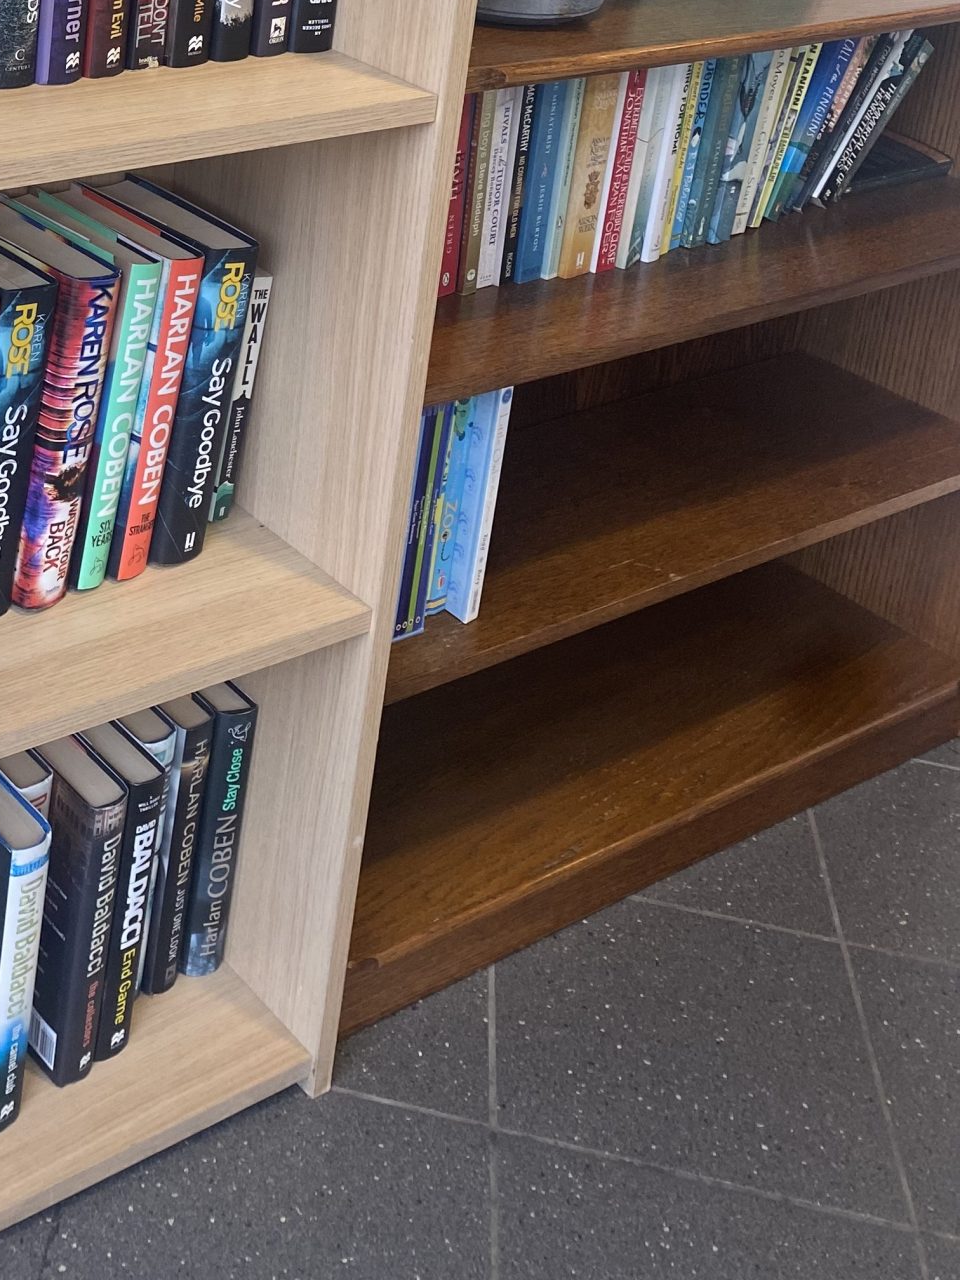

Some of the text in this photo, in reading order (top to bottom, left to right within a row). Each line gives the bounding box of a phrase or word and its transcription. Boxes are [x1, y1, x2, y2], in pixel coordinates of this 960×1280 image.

[110, 12, 124, 40] Evil
[792, 57, 814, 107] RANKIN
[501, 106, 511, 145] RIVALS
[519, 105, 533, 152] McCARTHY
[545, 95, 558, 154] MINIATURIST
[671, 123, 681, 155] HOME
[806, 86, 835, 138] PENGUINS
[856, 102, 887, 151] IMMORTAL
[602, 89, 636, 255] JONATHAN FOER
[472, 193, 484, 237] Biddulph
[489, 168, 504, 246] TUDOR COURT
[254, 289, 269, 300] THE
[5, 302, 38, 380] ROSE
[242, 303, 266, 386] WALL
[96, 278, 159, 518] HARLAN COBEN
[138, 274, 198, 506] HARLAN COBEN
[222, 748, 244, 812] Stay Close
[135, 819, 157, 833] DAVID
[87, 831, 122, 978] David Baldacci
[114, 827, 156, 1025] BALDACCI End Game
